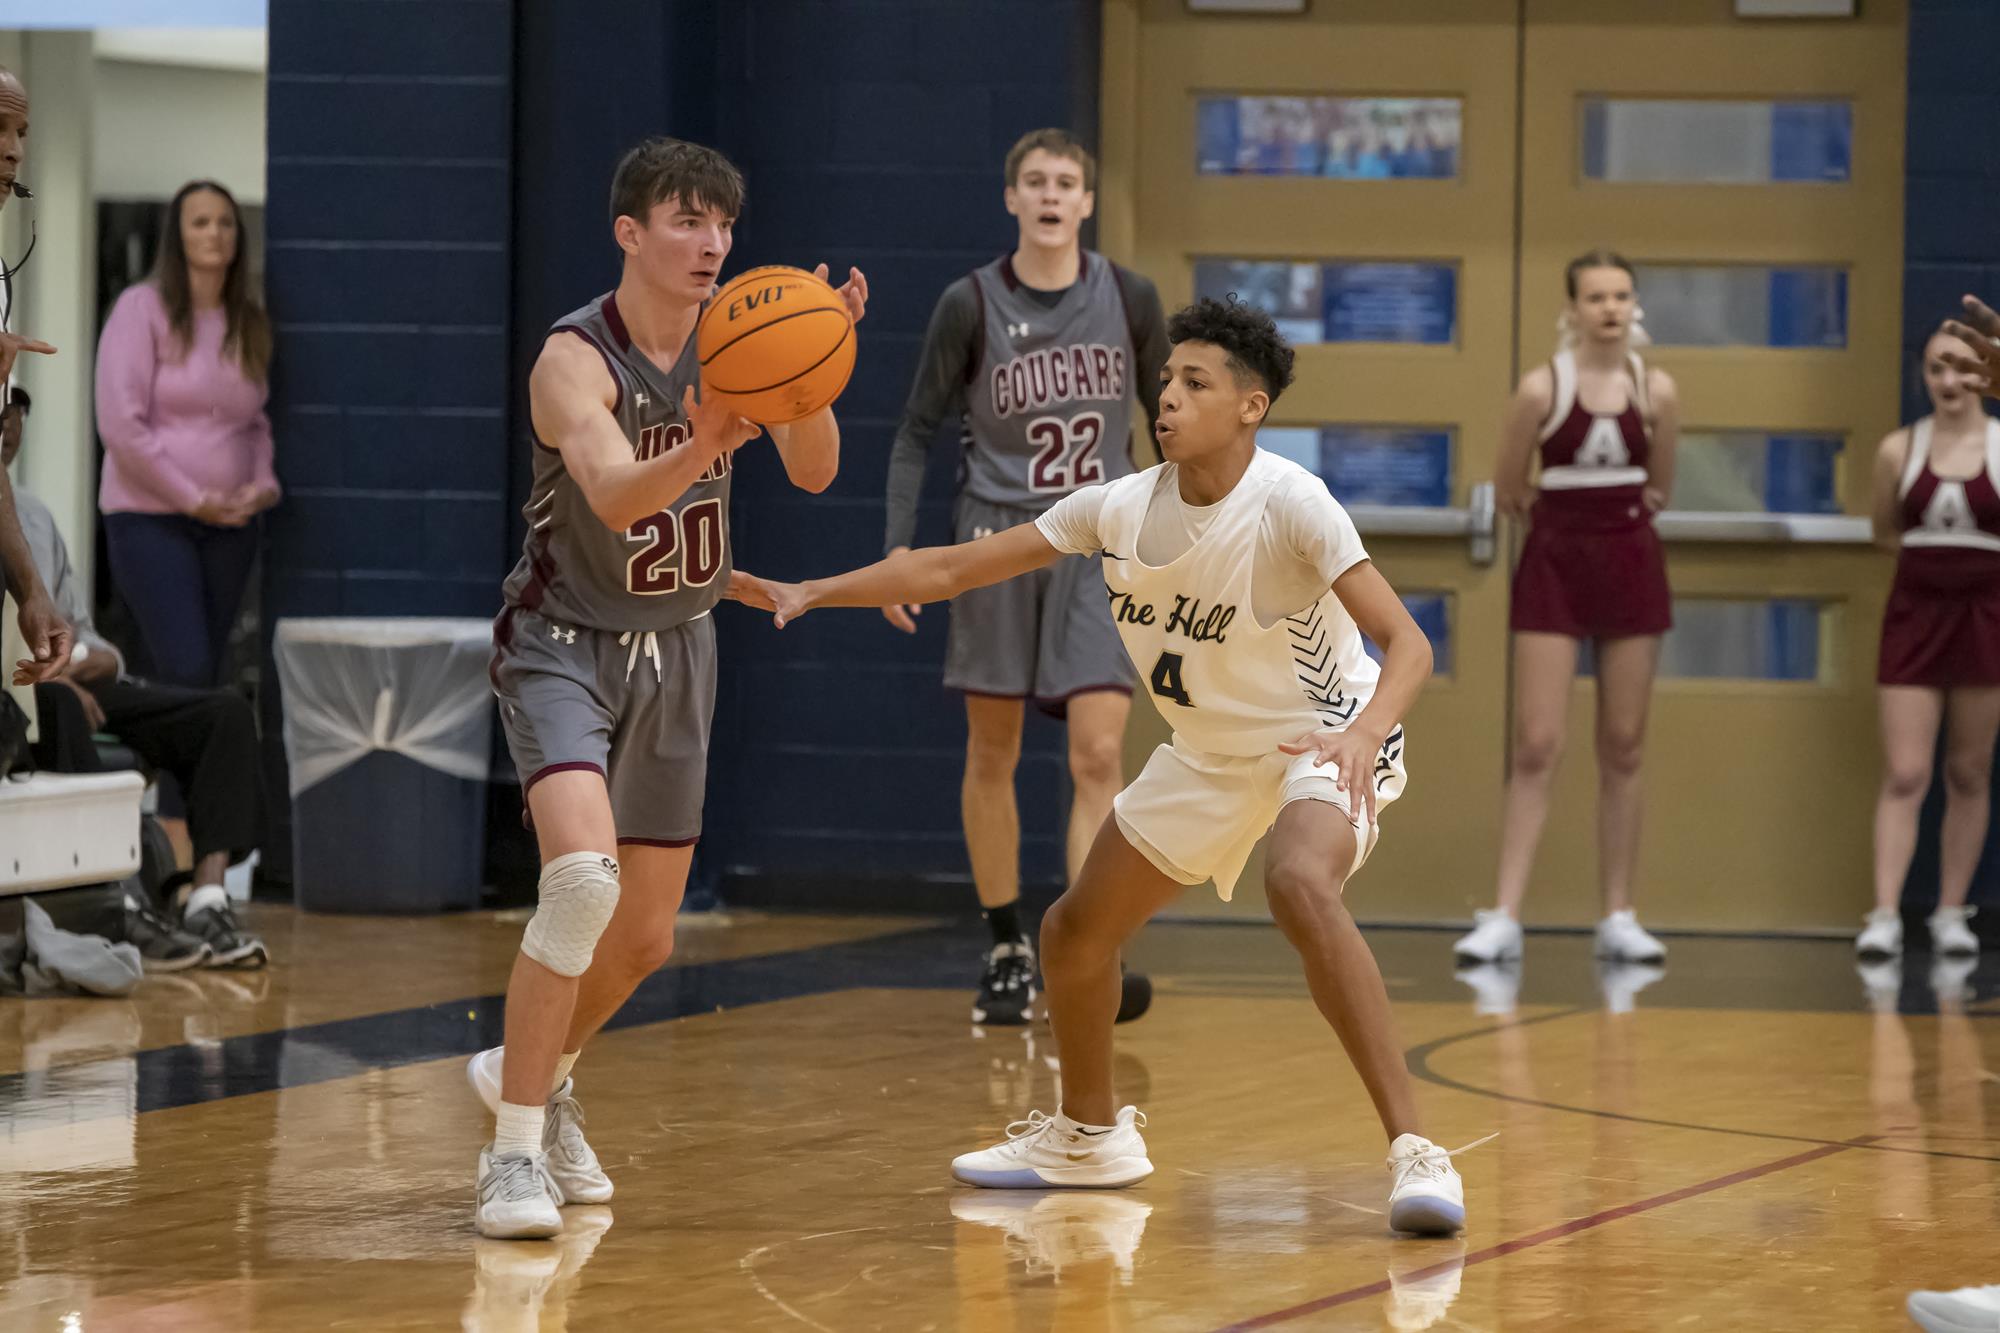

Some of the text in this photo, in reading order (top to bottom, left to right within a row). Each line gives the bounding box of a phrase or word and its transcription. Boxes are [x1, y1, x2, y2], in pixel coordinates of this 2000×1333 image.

[728, 285, 783, 322] EVO
[991, 343, 1126, 419] COUGARS
[1026, 411, 1106, 494] 22
[1573, 416, 1632, 467] A
[1921, 480, 1978, 531] A
[625, 498, 724, 596] 20
[1104, 582, 1156, 626] The
[1150, 649, 1197, 708] 4
